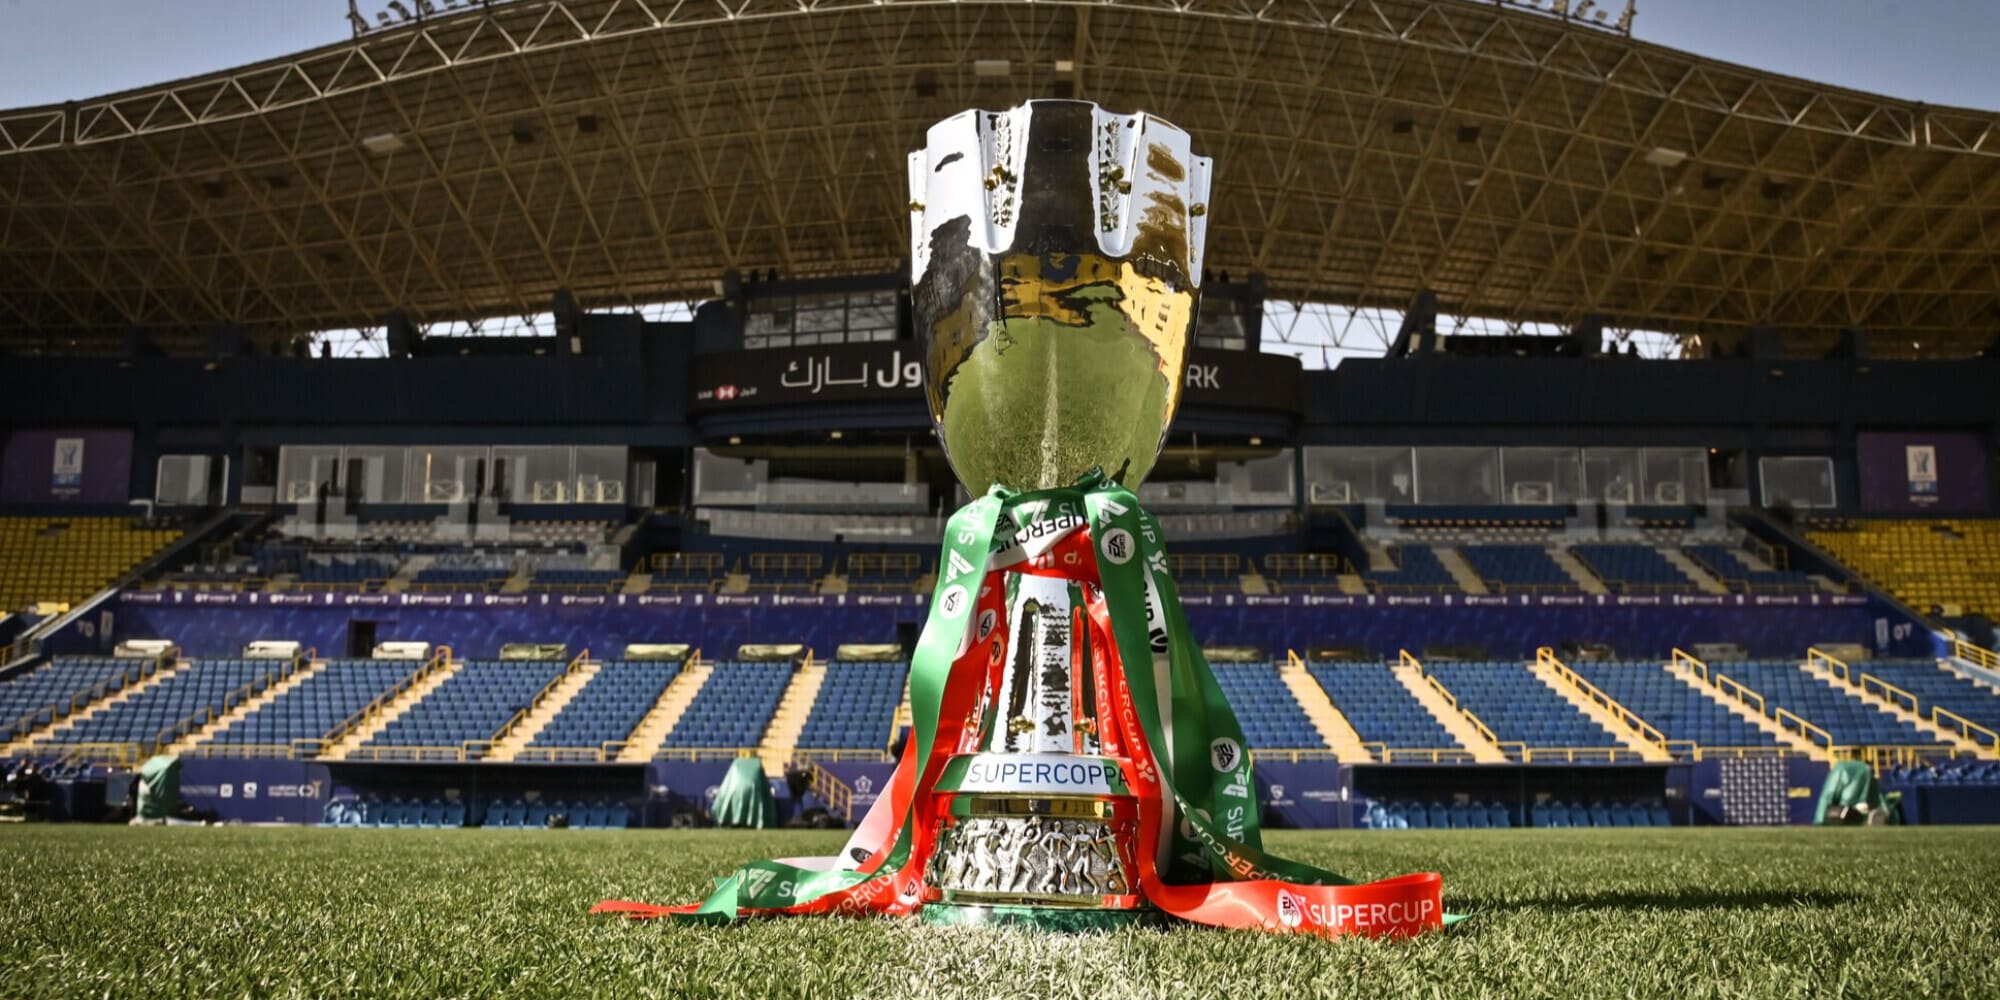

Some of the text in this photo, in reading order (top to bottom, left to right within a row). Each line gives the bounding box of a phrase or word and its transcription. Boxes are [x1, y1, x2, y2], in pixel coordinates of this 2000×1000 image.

[781, 351, 922, 394] ول بارك
[1186, 364, 1219, 389] RK
[969, 761, 1129, 786] SUPERCOPPA
[1310, 898, 1434, 928] SUPERCUP
